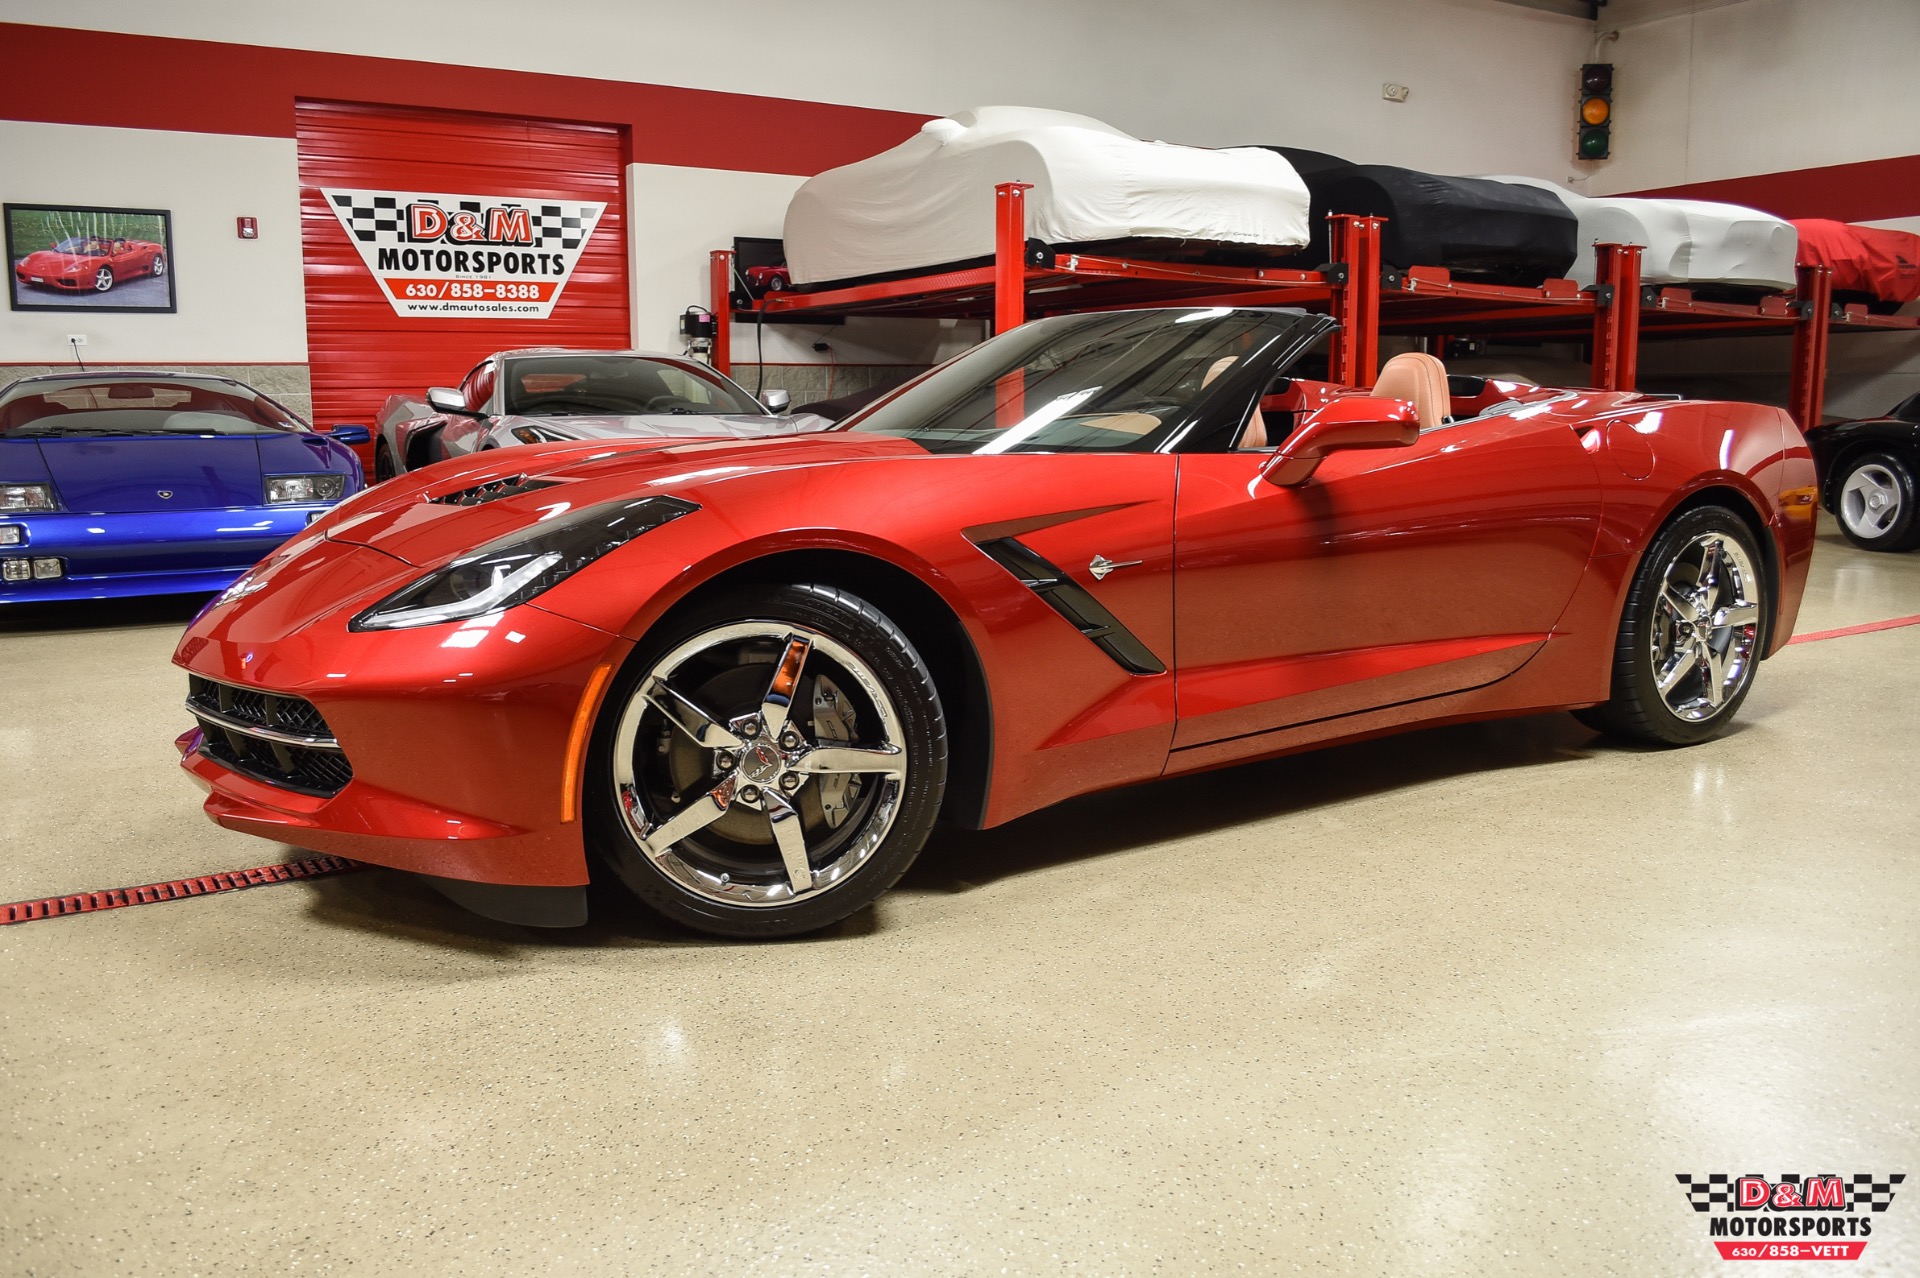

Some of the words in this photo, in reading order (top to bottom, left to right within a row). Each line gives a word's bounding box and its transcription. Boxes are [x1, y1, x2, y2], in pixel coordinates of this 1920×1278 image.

[408, 203, 533, 245] D&M
[378, 248, 565, 276] MOTORSPORTS
[405, 281, 540, 299] 630/858-8388
[407, 302, 539, 313] www.dmautosales.com
